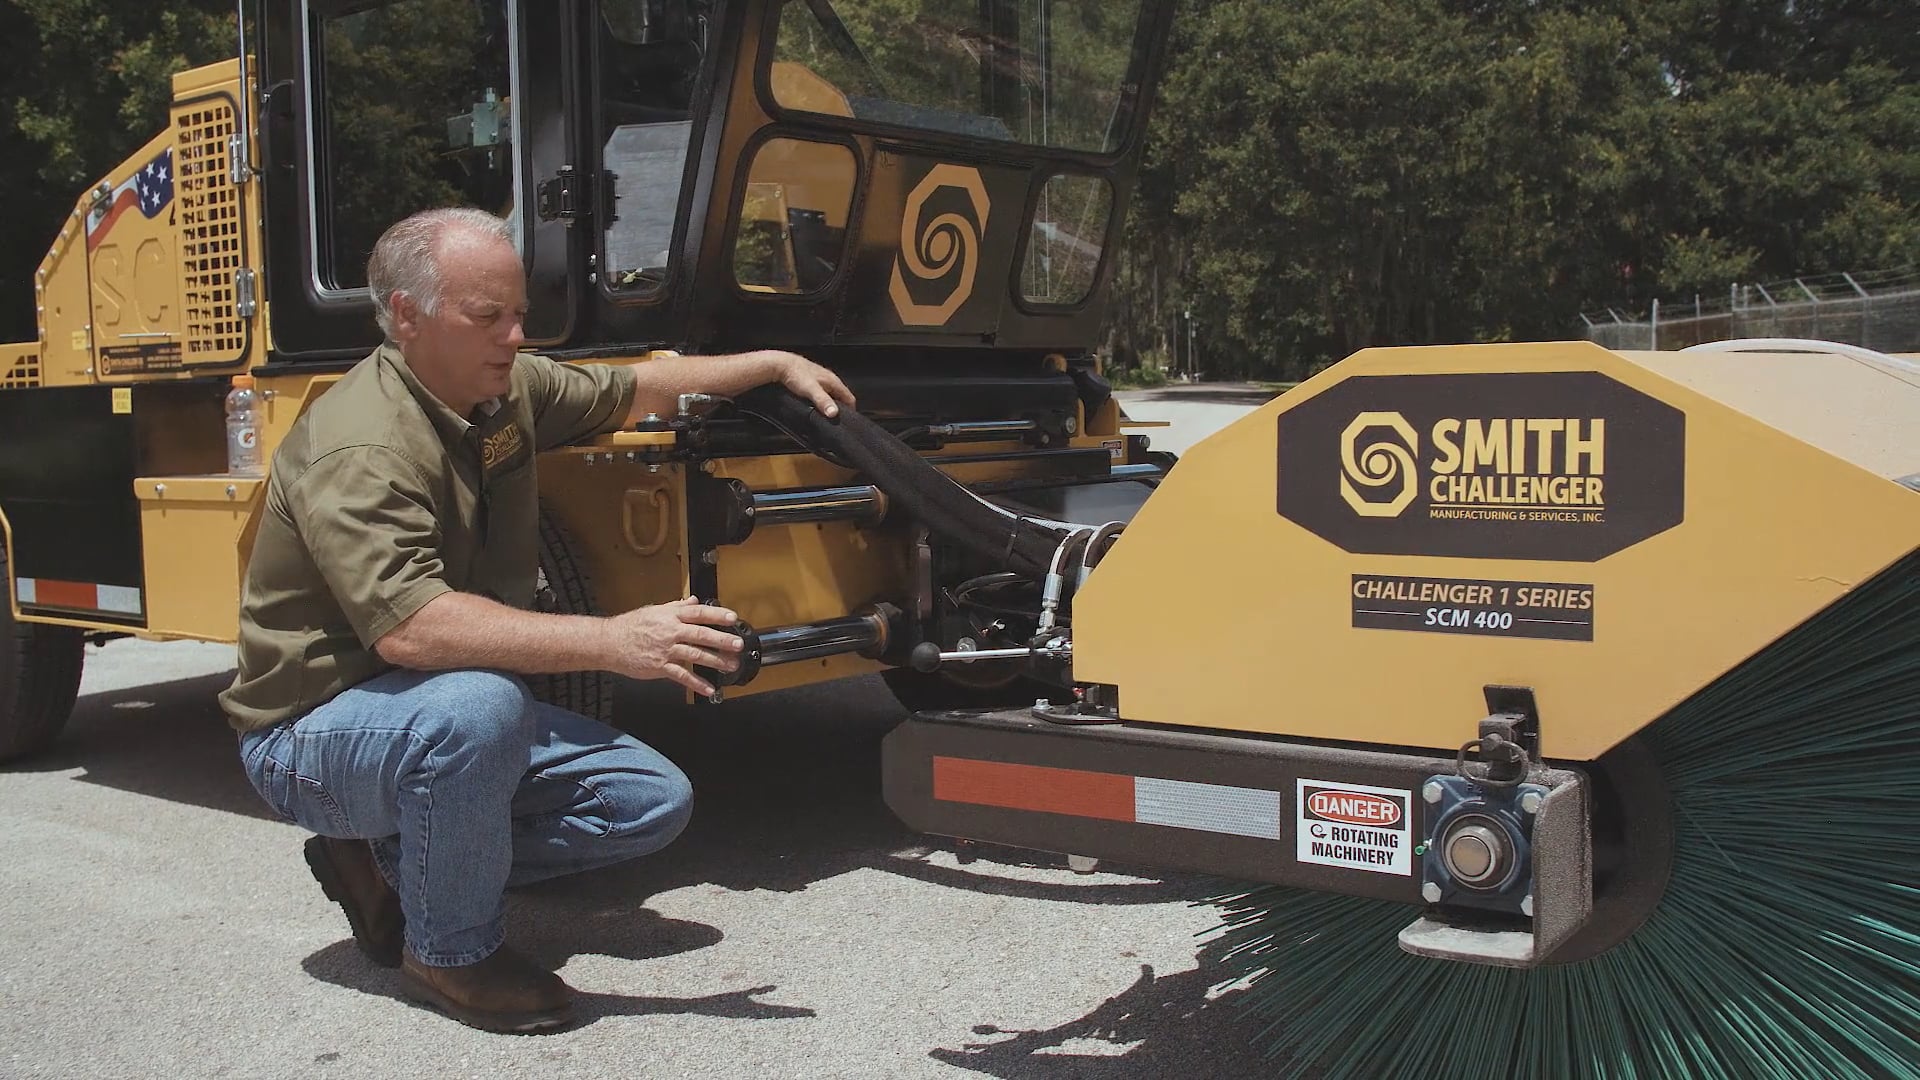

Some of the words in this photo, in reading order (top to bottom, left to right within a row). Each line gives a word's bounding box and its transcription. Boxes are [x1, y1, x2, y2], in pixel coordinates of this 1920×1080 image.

[238, 428, 256, 449] G
[1430, 418, 1605, 474] SMITH
[1430, 475, 1605, 505] CHALLENGER
[1430, 509, 1517, 520] MANUFACTURING
[1519, 510, 1526, 521] &
[1528, 511, 1581, 523] SERVICES,
[1583, 512, 1605, 523] INC.
[1353, 580, 1493, 605] CHALLENGER
[1499, 587, 1508, 605] 1
[1515, 587, 1593, 610] SERIES
[1425, 607, 1470, 628] SCM
[1474, 611, 1513, 630] 400
[1314, 795, 1394, 821] DANGER
[1331, 826, 1399, 849] ROTATING
[1311, 841, 1394, 866] MACHINERY
